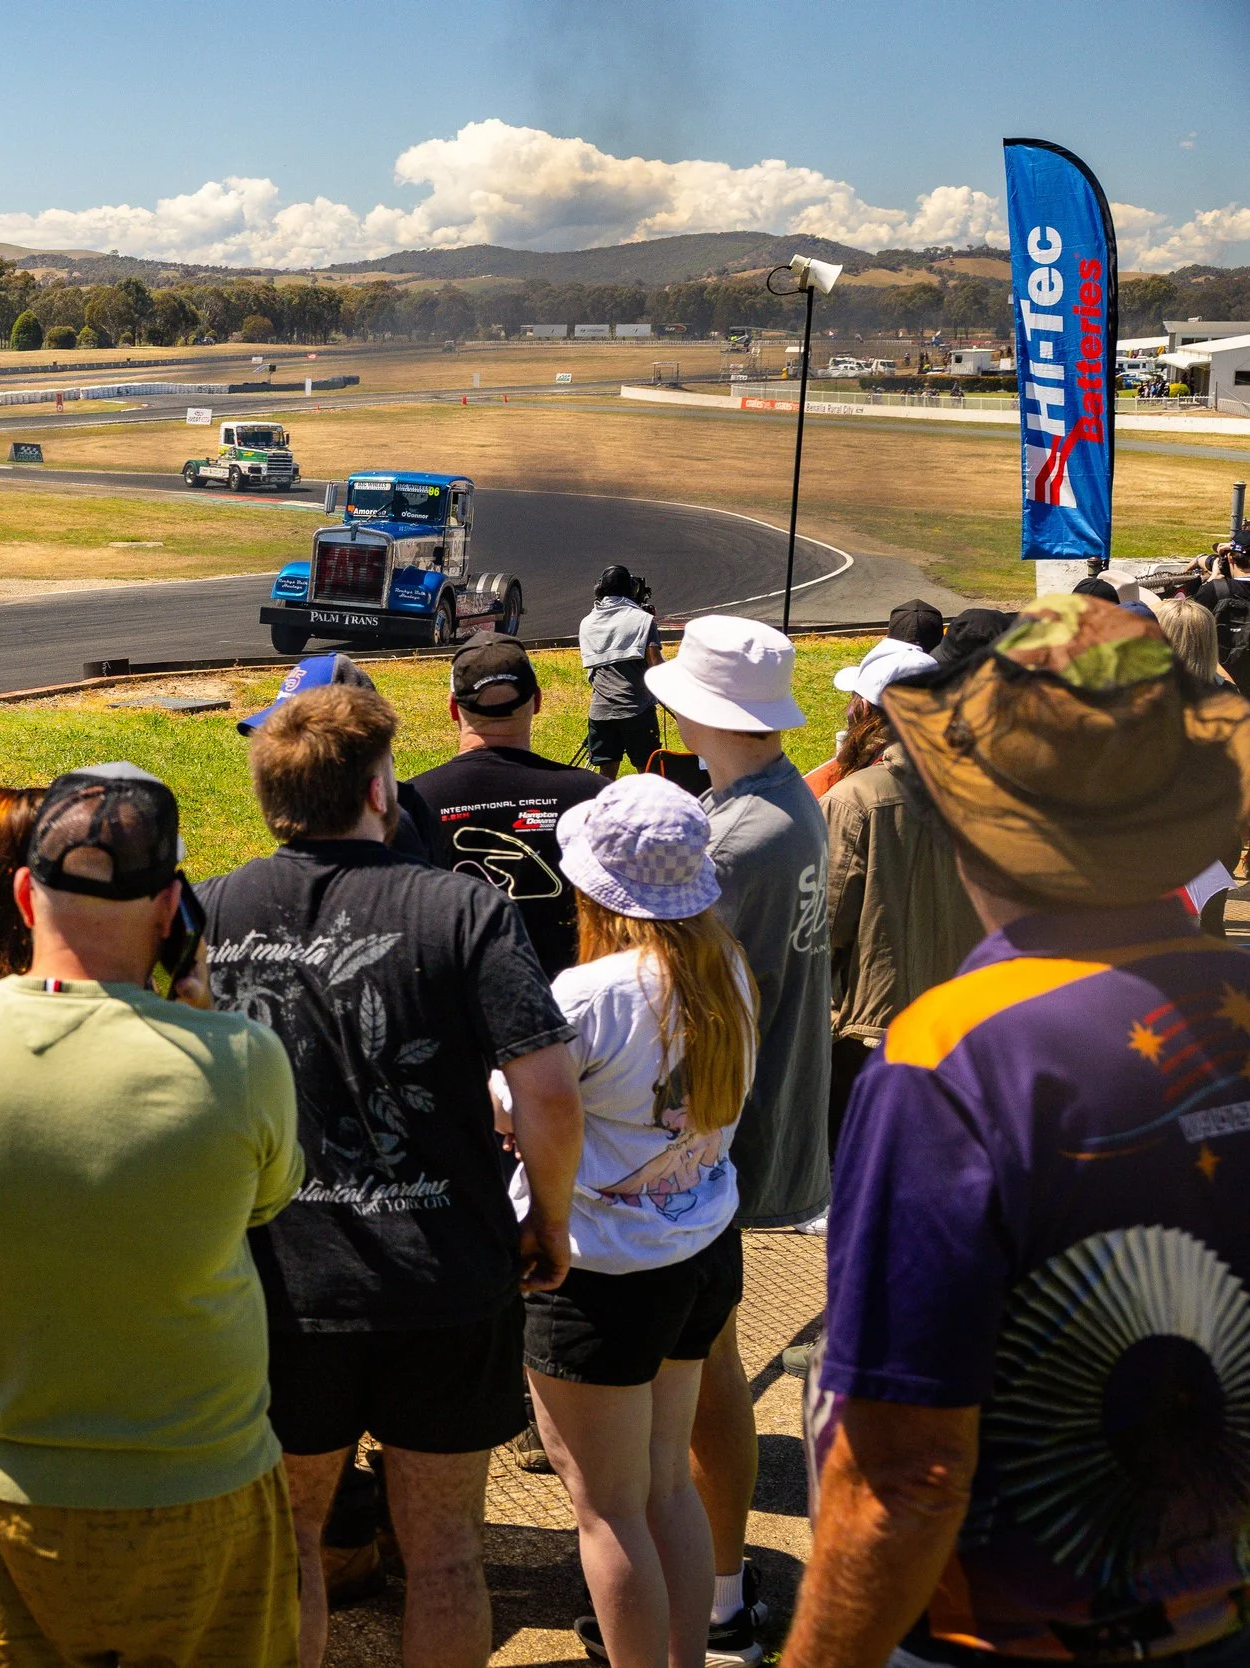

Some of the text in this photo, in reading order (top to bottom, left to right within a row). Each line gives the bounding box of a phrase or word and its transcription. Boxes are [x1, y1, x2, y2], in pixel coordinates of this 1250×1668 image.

[1073, 258, 1104, 443] Batteries
[806, 401, 826, 412] Benalla
[827, 402, 842, 414] Rural
[843, 403, 854, 415] City
[428, 486, 440, 497] 96
[401, 510, 429, 519] O'Connor
[310, 610, 379, 627] PALM TRANS
[440, 798, 558, 815] INTERNATIONAL CIRCUIT
[518, 811, 558, 819] Hampton
[383, 1198, 422, 1213] YORK
[423, 1194, 451, 1209] CITY
